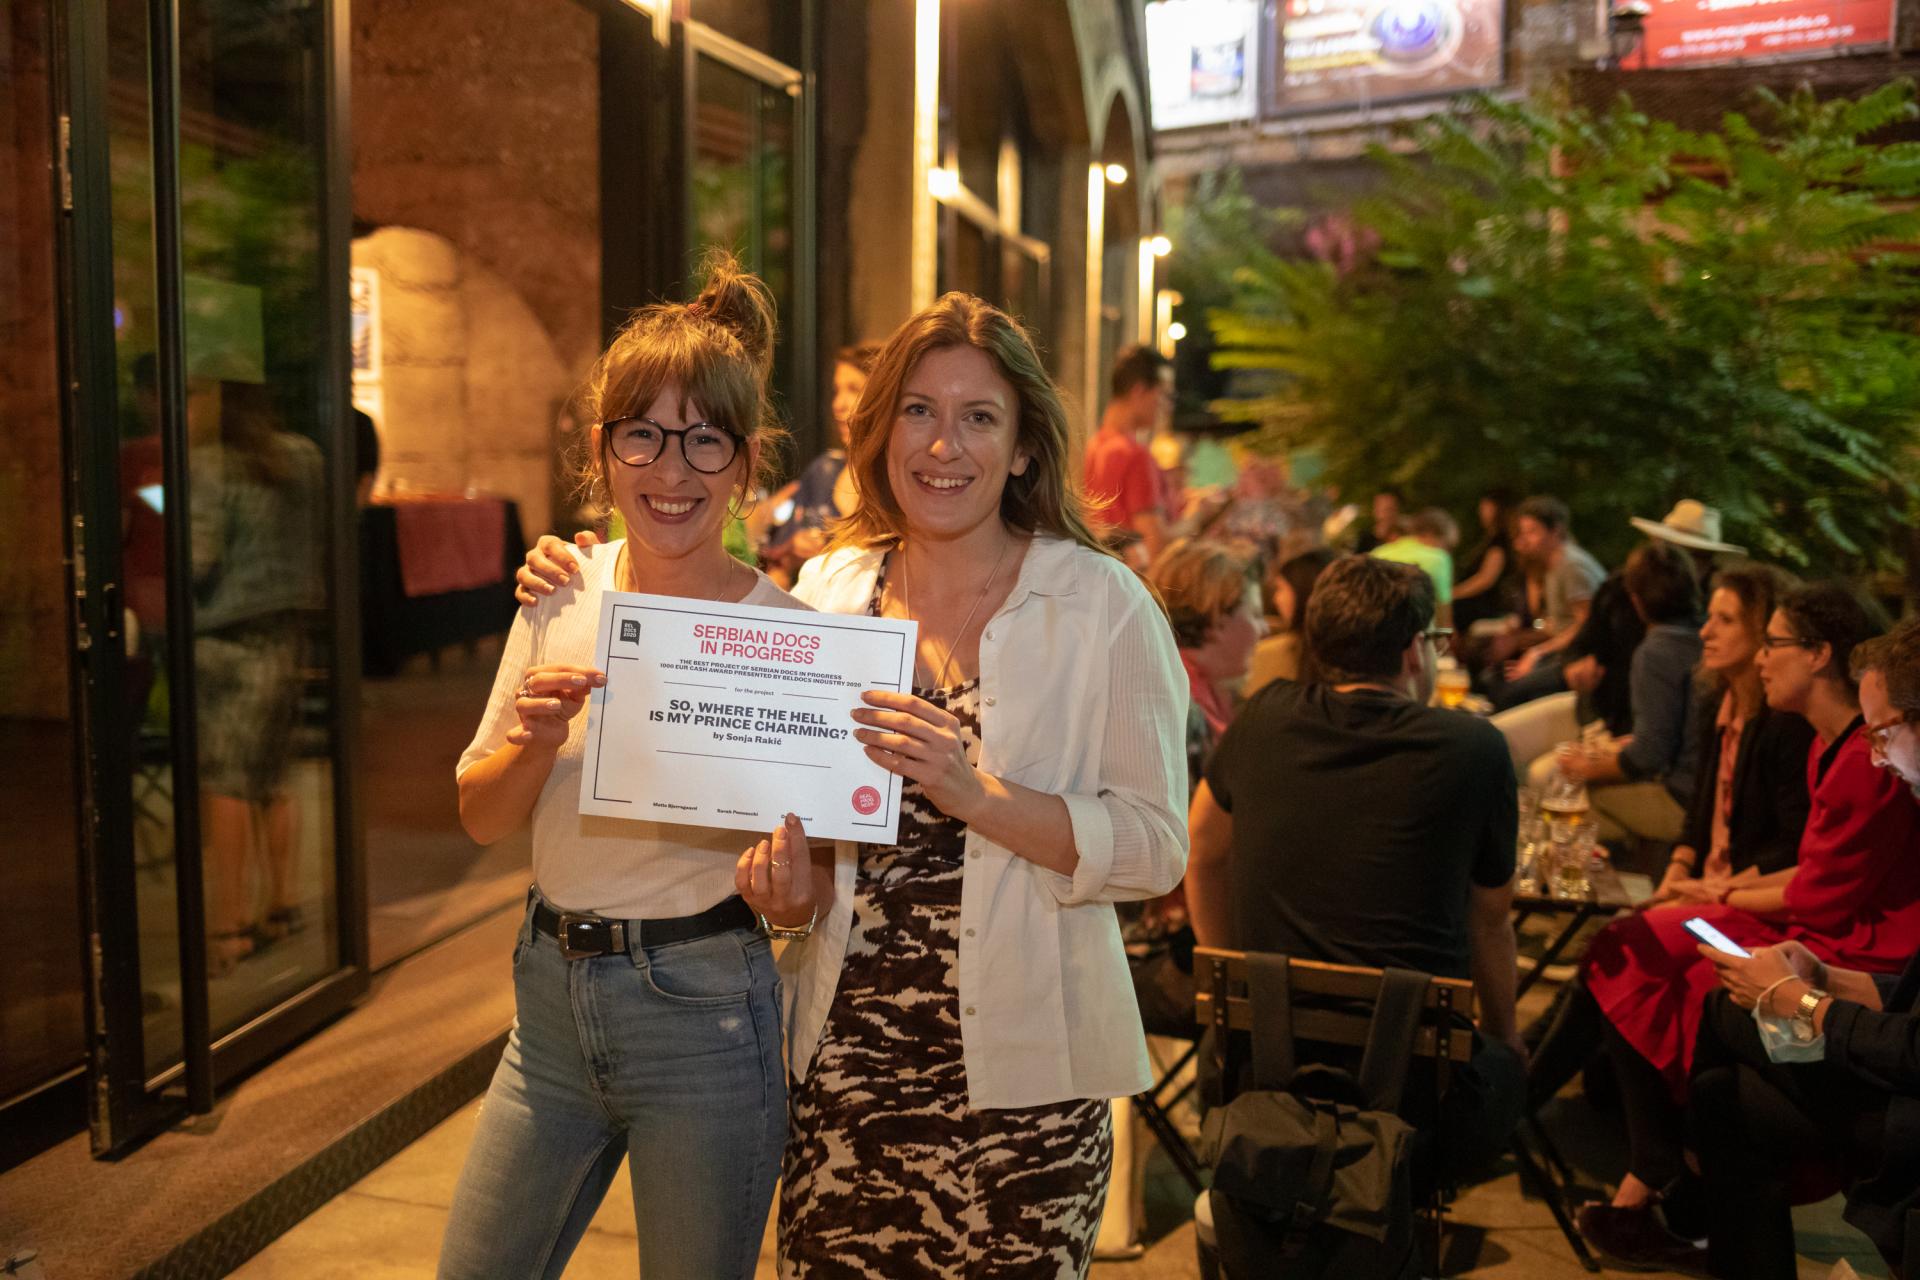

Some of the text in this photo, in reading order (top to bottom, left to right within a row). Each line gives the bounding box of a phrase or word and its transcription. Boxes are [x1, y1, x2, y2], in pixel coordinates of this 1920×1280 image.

[693, 623, 821, 649] SERBIAN DOCS
[700, 640, 815, 664] IN PROGRESS
[708, 667, 733, 675] AWARD
[733, 670, 772, 679] PRESENTED
[782, 675, 812, 683] BELDOCS
[812, 678, 845, 687] INDUSTRY
[750, 666, 779, 674] SERBIAN
[807, 672, 842, 680] PROGRESS
[669, 699, 827, 725] SO, WHERE THE HELL
[649, 710, 848, 740] IS MY PRINCE CHARMING?
[713, 732, 782, 745] by Sonja Rakić
